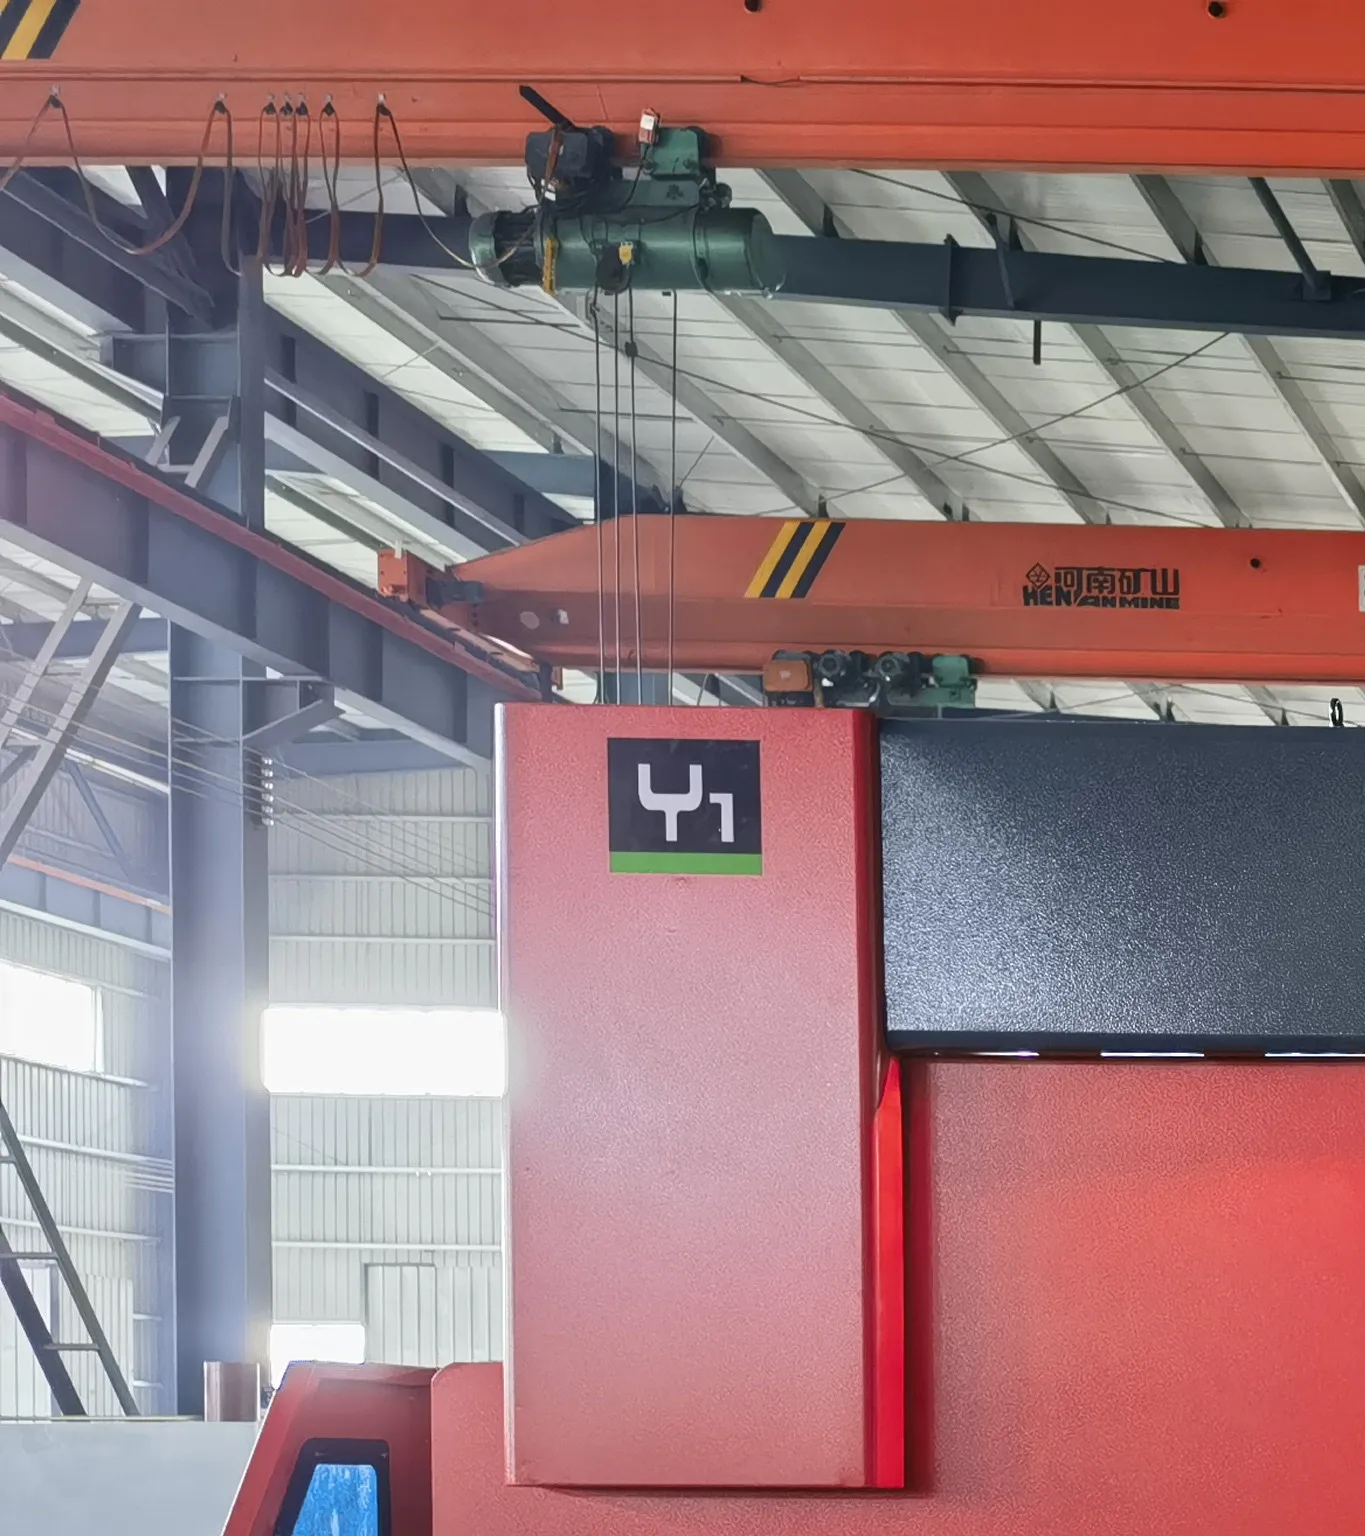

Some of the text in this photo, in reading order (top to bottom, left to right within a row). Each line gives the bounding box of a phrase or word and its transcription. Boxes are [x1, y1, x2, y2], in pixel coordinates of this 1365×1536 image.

[1054, 566, 1180, 597] 河南矿山
[637, 763, 735, 843] Y1
